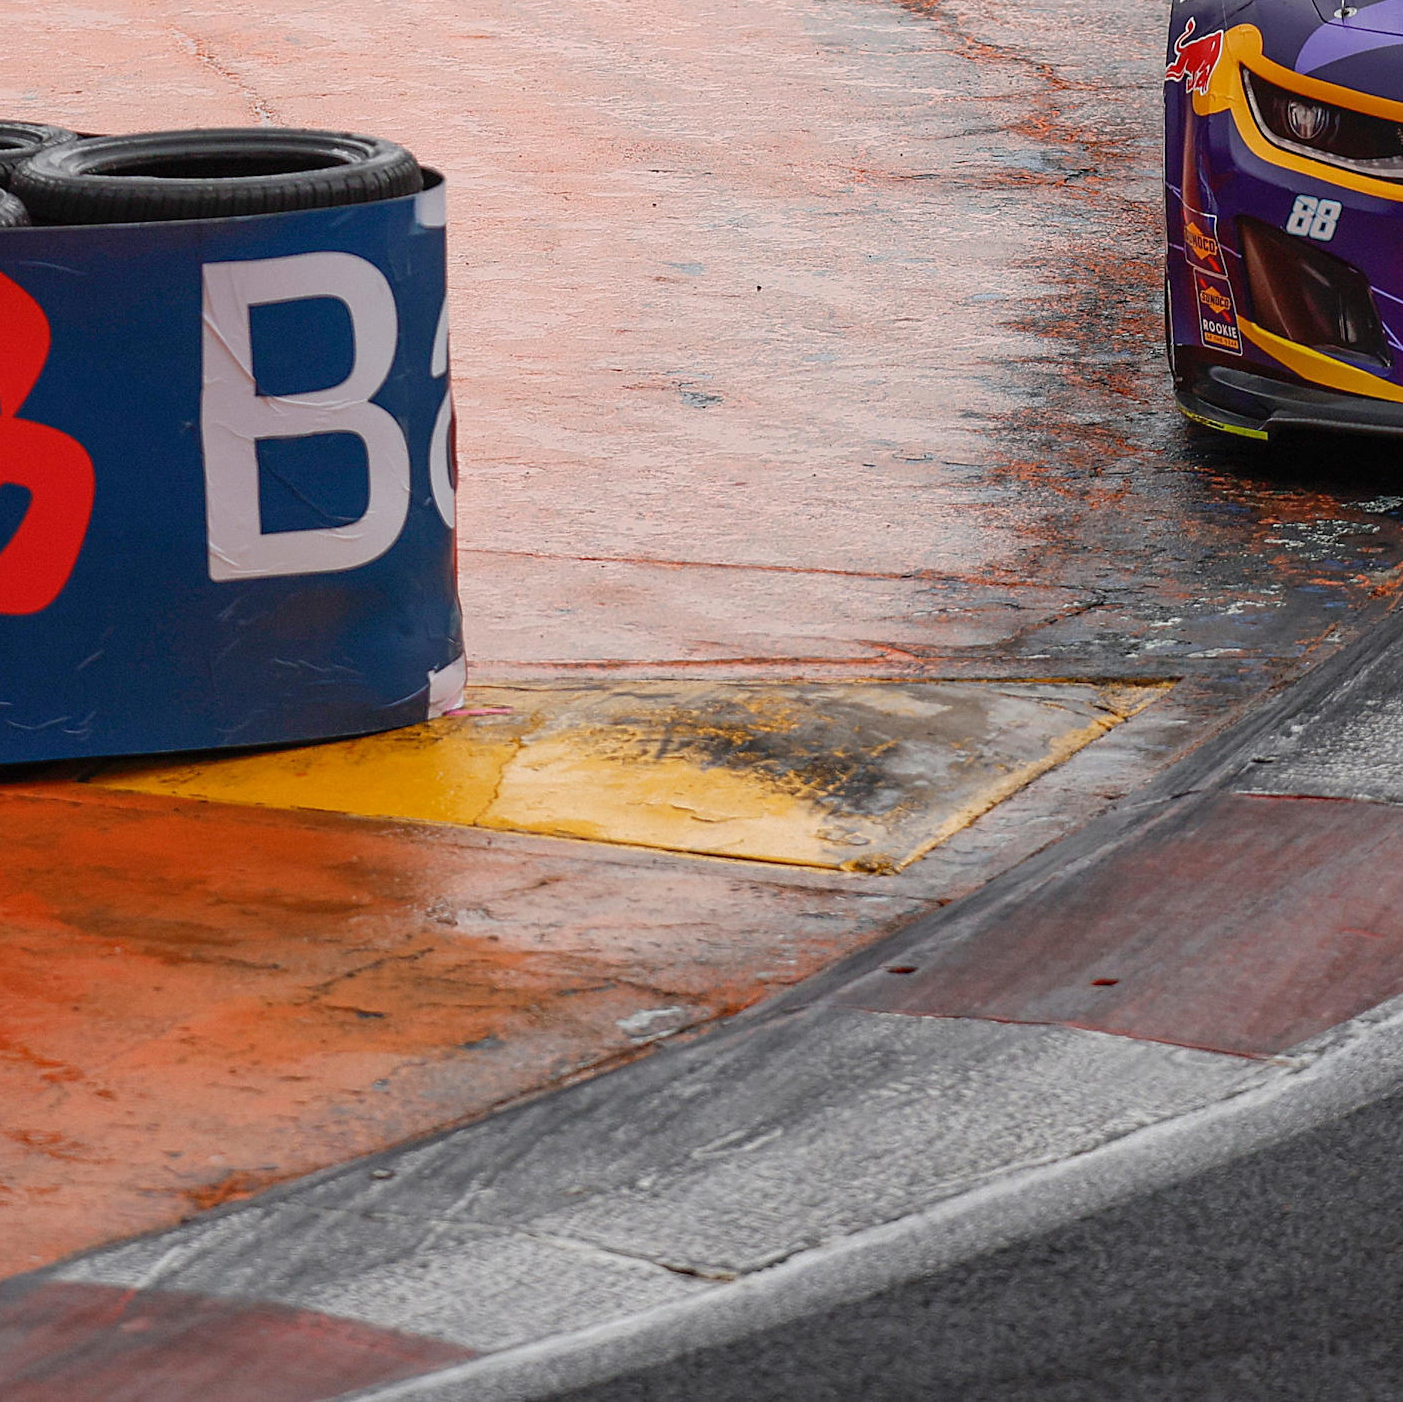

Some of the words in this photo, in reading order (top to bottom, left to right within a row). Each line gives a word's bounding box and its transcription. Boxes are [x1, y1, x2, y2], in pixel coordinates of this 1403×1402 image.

[1285, 194, 1343, 242] 88
[1200, 290, 1231, 309] SUNOCO
[1202, 318, 1238, 339] ROOKIE
[200, 250, 456, 583] B
